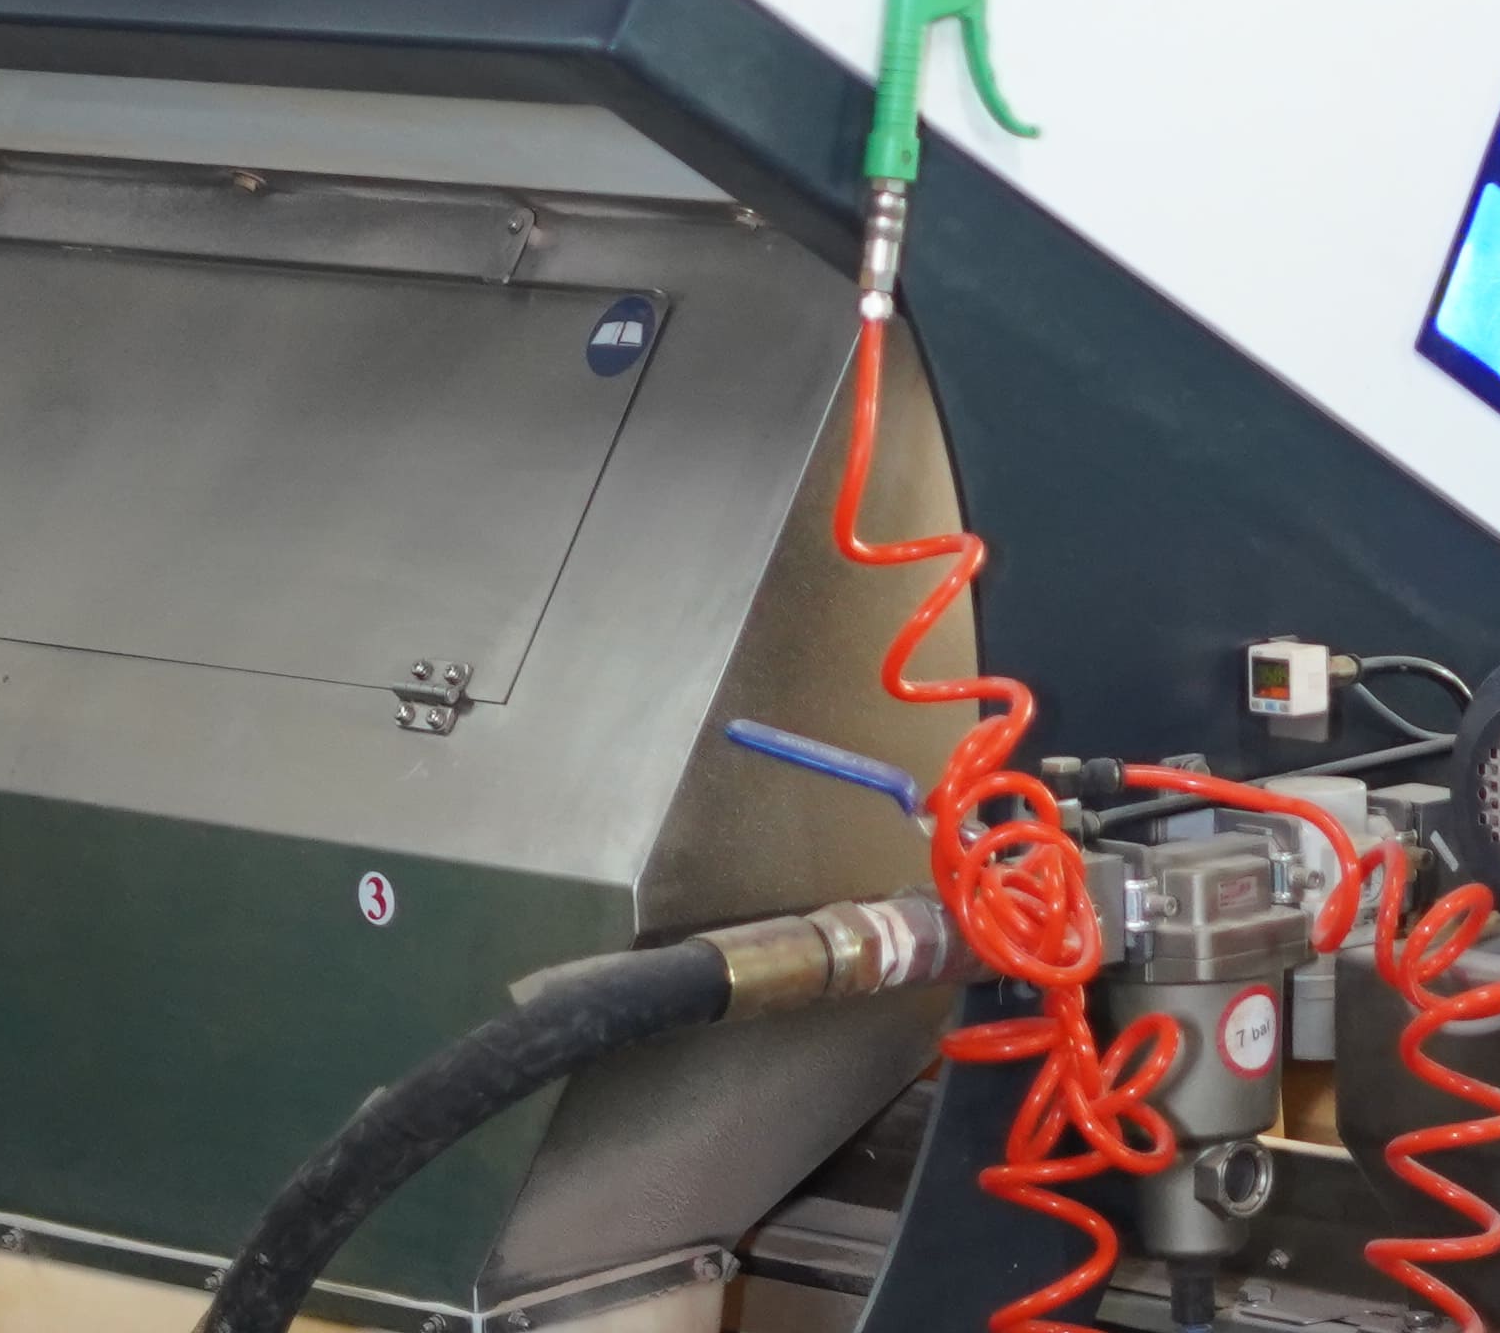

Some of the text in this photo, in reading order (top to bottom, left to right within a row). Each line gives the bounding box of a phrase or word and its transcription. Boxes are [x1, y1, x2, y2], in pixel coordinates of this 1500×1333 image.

[366, 876, 387, 921] 3
[1236, 1020, 1270, 1047] 7 bar
